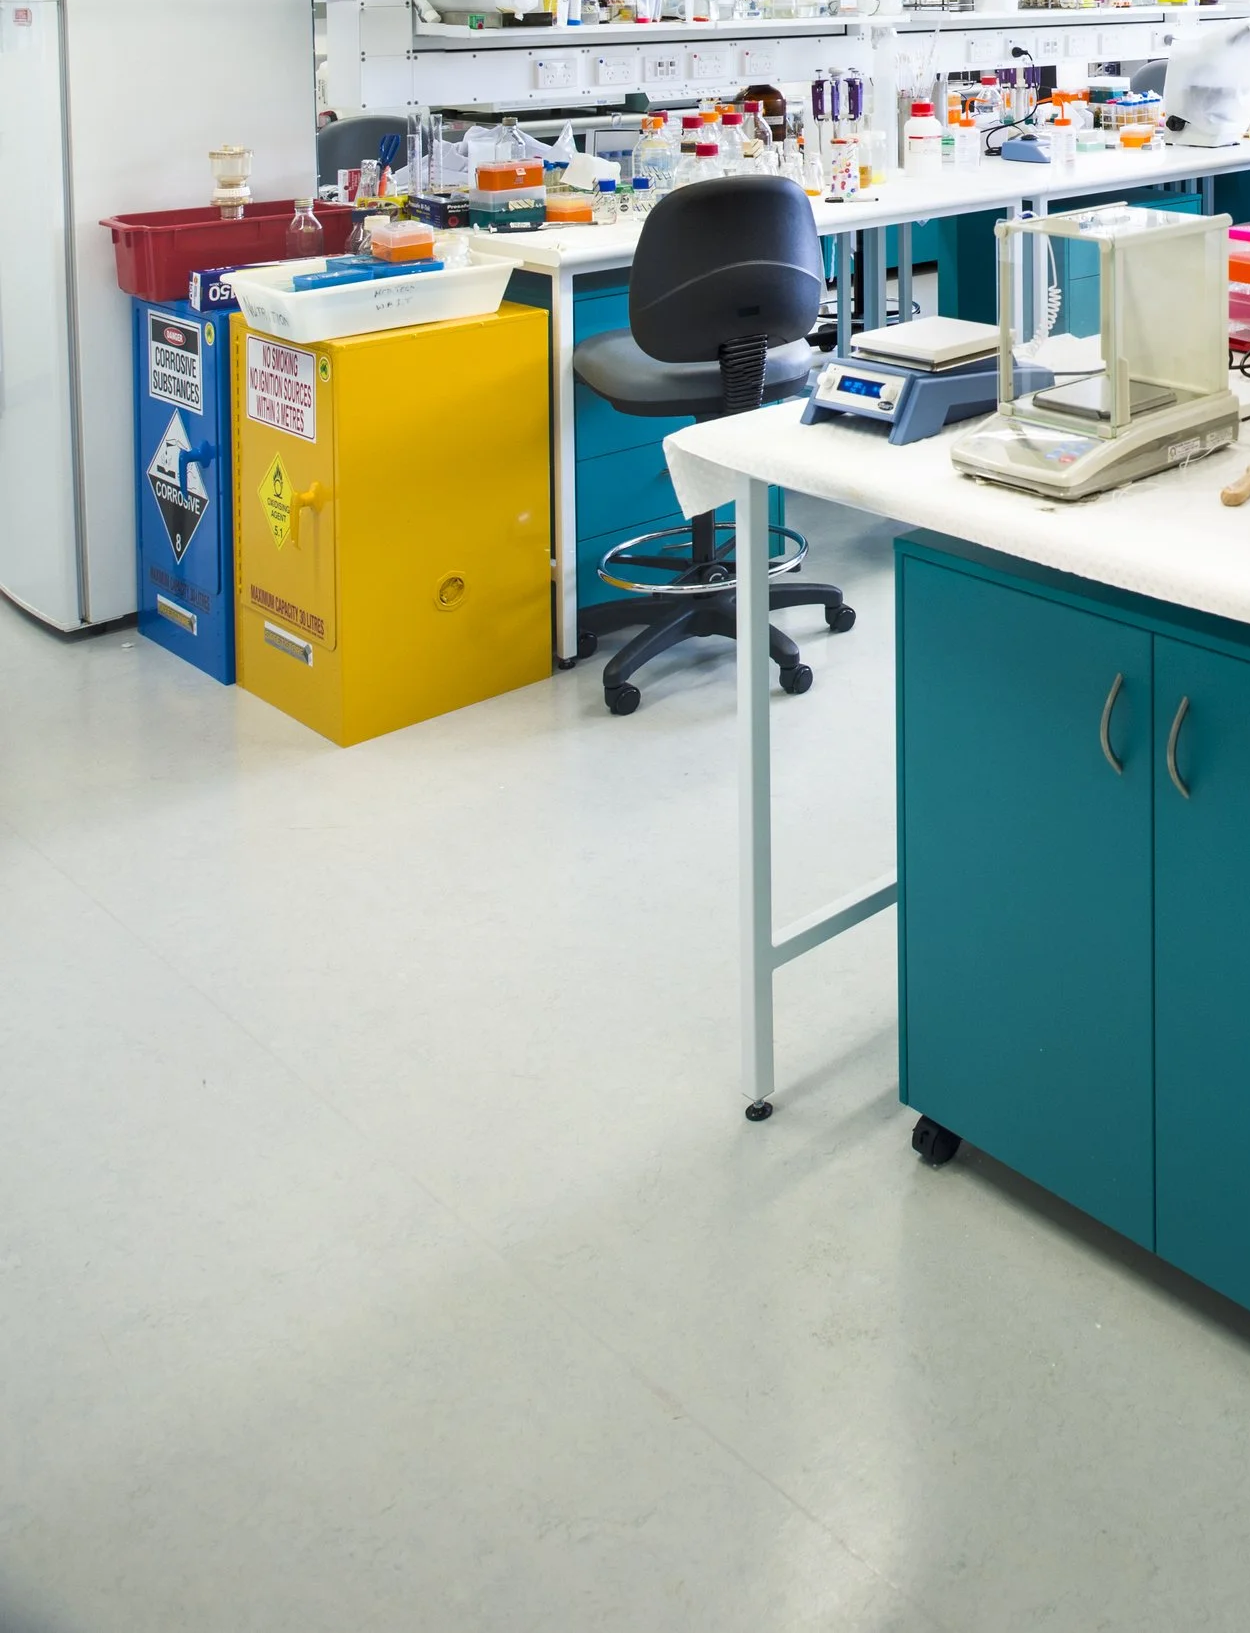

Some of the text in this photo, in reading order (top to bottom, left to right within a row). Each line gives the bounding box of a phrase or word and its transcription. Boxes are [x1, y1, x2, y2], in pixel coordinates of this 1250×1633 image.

[166, 330, 184, 343] DANGER
[155, 346, 197, 378] CORROSIVE
[263, 345, 298, 377] NO SMOKING
[153, 370, 200, 404] SUBSTANCES
[250, 367, 312, 408] NO IGNITION SOURCES
[256, 394, 276, 421] WITHIN
[281, 403, 305, 432] METRES
[271, 510, 287, 523] AGENT
[274, 525, 283, 538] 5.1
[176, 534, 181, 552] 8
[251, 584, 274, 609] MAXIMUM
[275, 596, 299, 622] CAPACITY
[307, 612, 325, 636] LITRES
